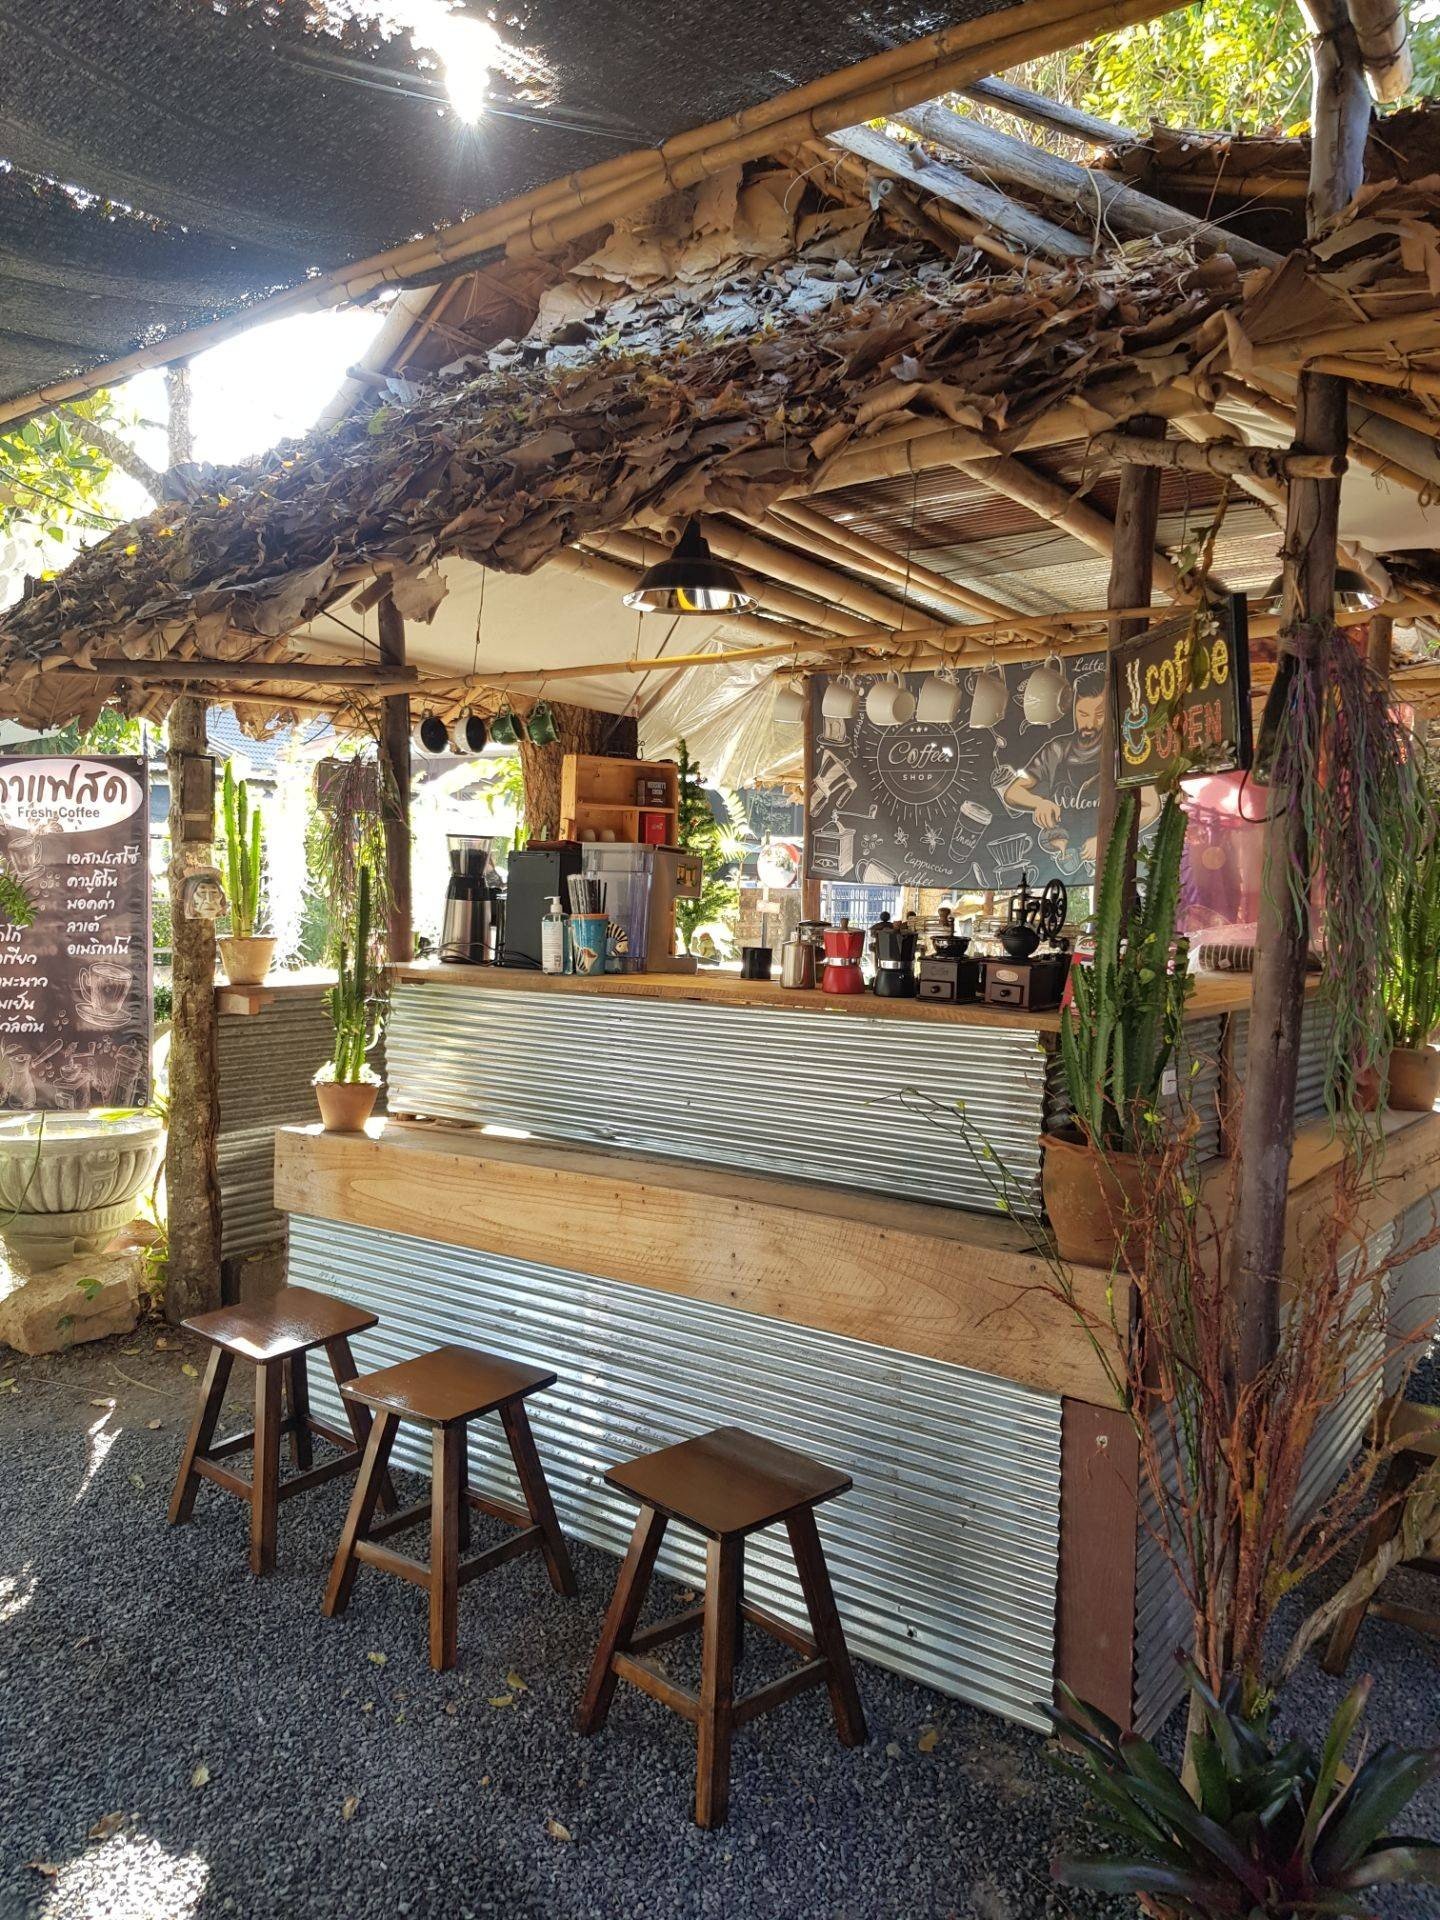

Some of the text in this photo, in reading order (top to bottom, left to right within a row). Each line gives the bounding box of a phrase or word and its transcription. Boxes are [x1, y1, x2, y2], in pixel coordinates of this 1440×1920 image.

[888, 741, 951, 769] Coffee
[1054, 780, 1100, 810] Welco
[17, 806, 100, 818] Fresh Coffee
[897, 870, 934, 887] Coffee
